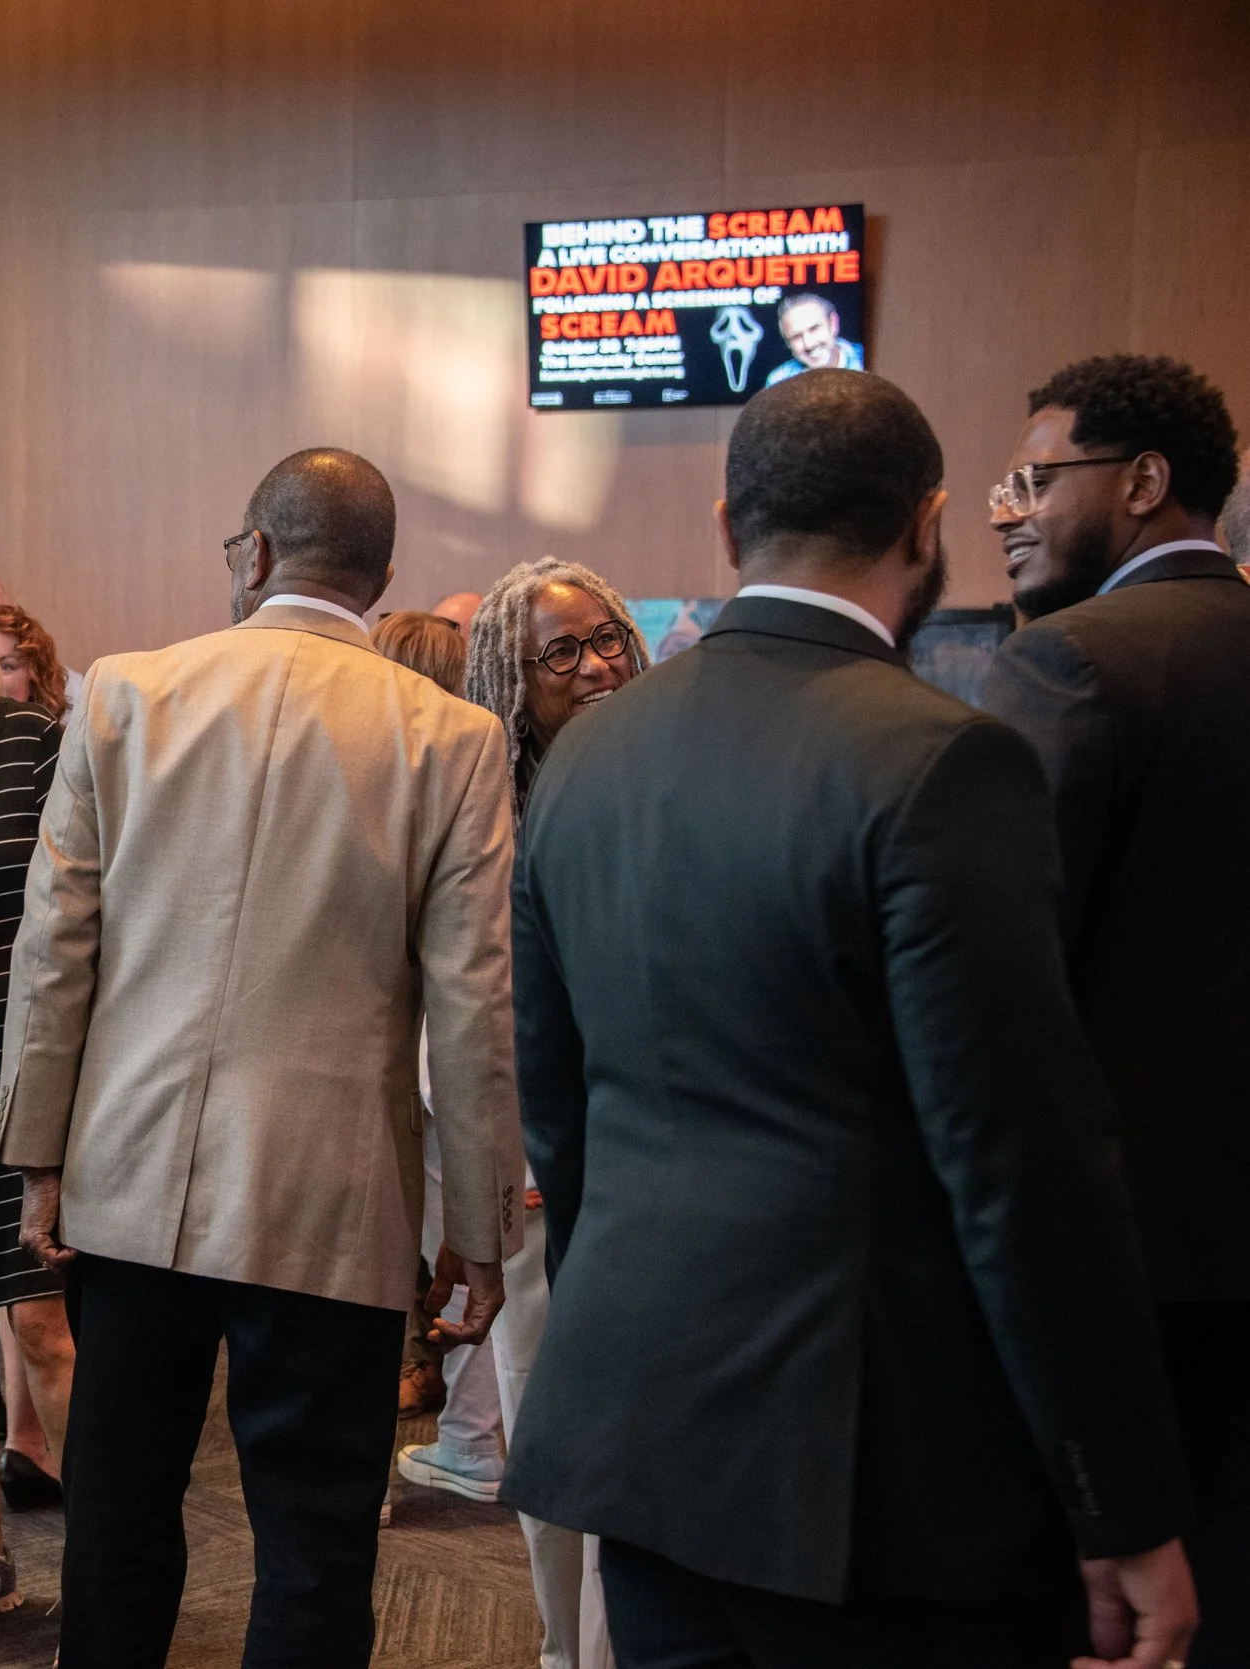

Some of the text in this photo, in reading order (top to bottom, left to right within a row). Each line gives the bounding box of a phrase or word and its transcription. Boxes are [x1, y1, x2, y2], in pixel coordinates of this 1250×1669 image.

[542, 206, 844, 248] BEHIND THE SCREAM
[537, 230, 849, 268] A LIVE CONVERSATION WITH
[530, 250, 860, 297] DAVID ARQUETTE
[532, 286, 782, 315] FOLLOWING A SCREENING OF
[540, 308, 677, 340] SCREAM
